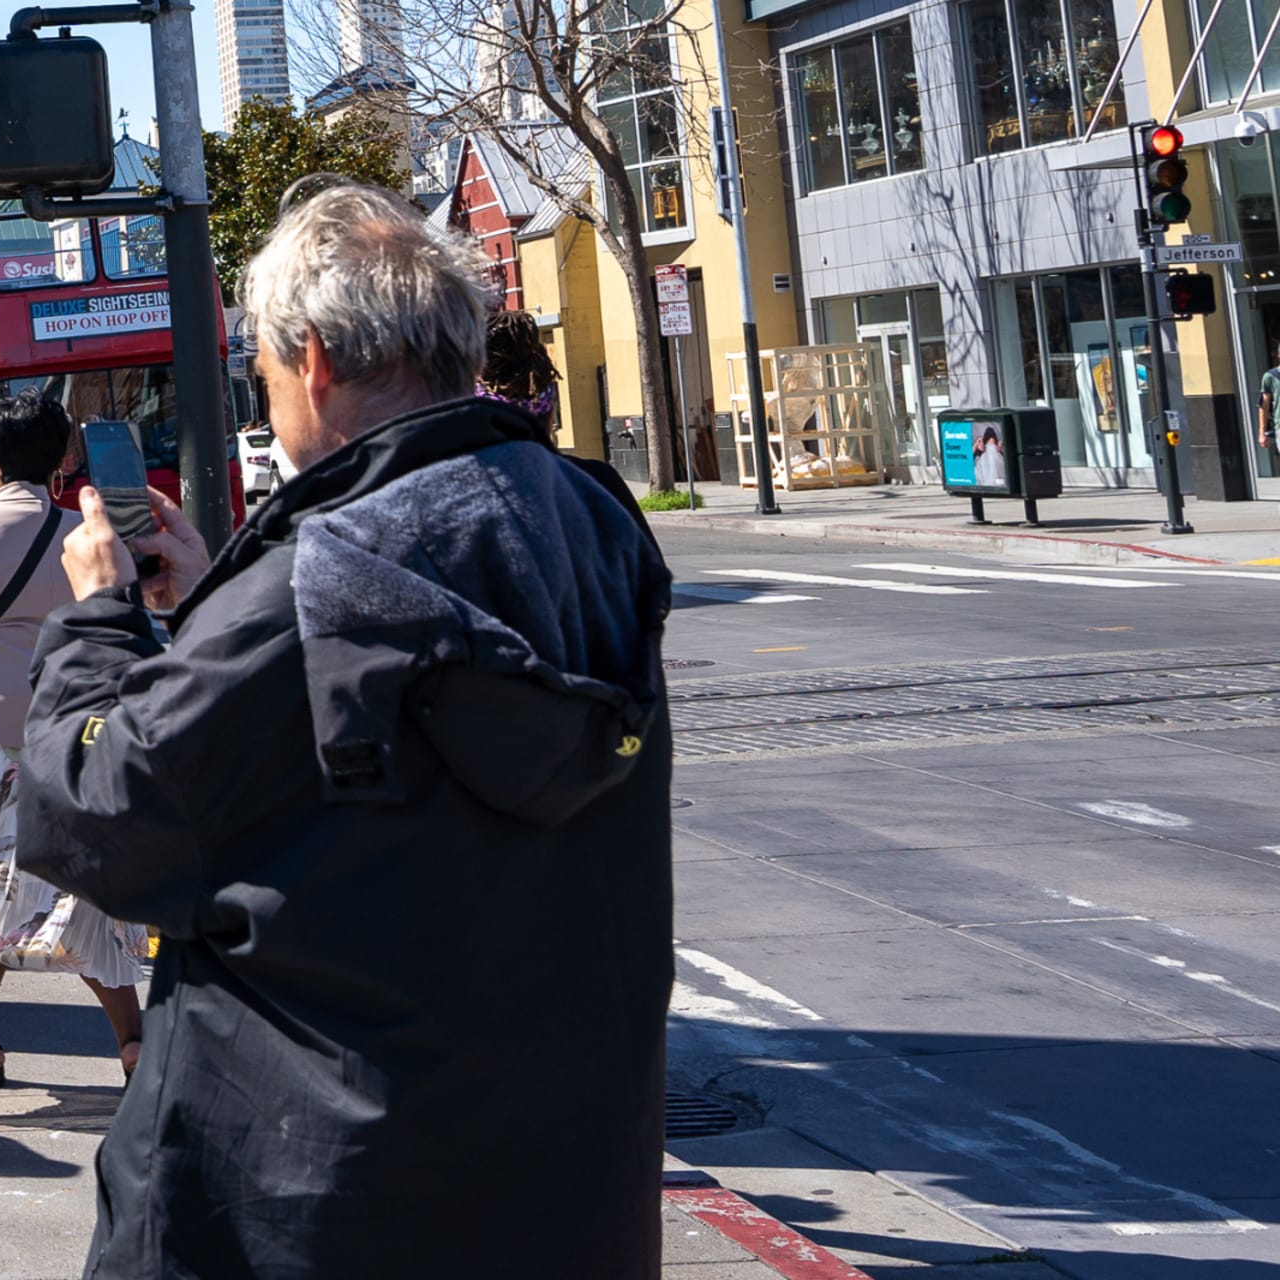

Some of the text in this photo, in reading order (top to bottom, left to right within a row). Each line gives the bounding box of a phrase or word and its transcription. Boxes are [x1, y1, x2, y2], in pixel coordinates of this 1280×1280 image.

[1164, 248, 1235, 260] Jefferson
[32, 291, 170, 317] DELUXE SIGHTSEEIN
[45, 310, 168, 333] HOP ON HOP OFF
